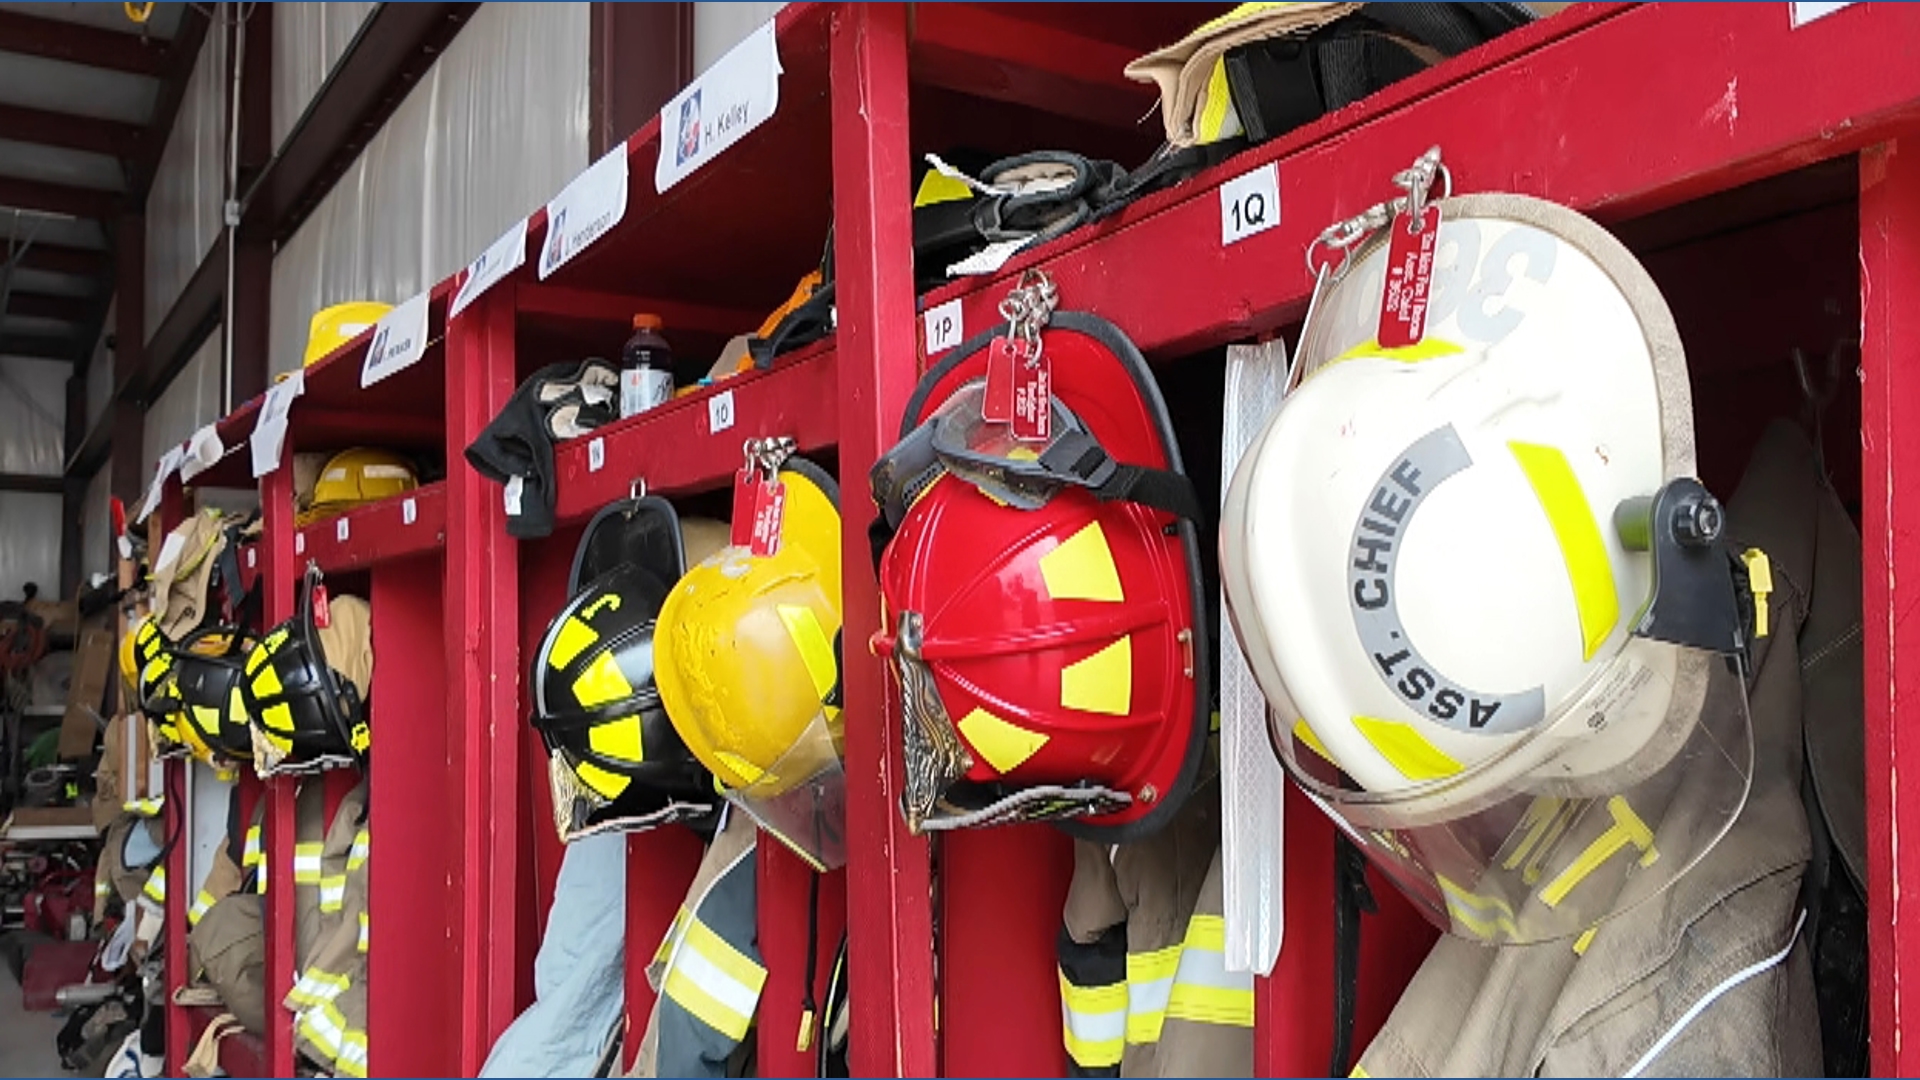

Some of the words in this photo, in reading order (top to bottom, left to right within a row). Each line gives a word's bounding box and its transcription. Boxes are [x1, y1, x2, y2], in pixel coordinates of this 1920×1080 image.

[717, 101, 750, 136] Kelley
[1231, 192, 1265, 232] 1Q
[934, 316, 952, 346] 1P
[1354, 458, 1422, 611] CHIEF
[1374, 630, 1502, 728] ASST.
